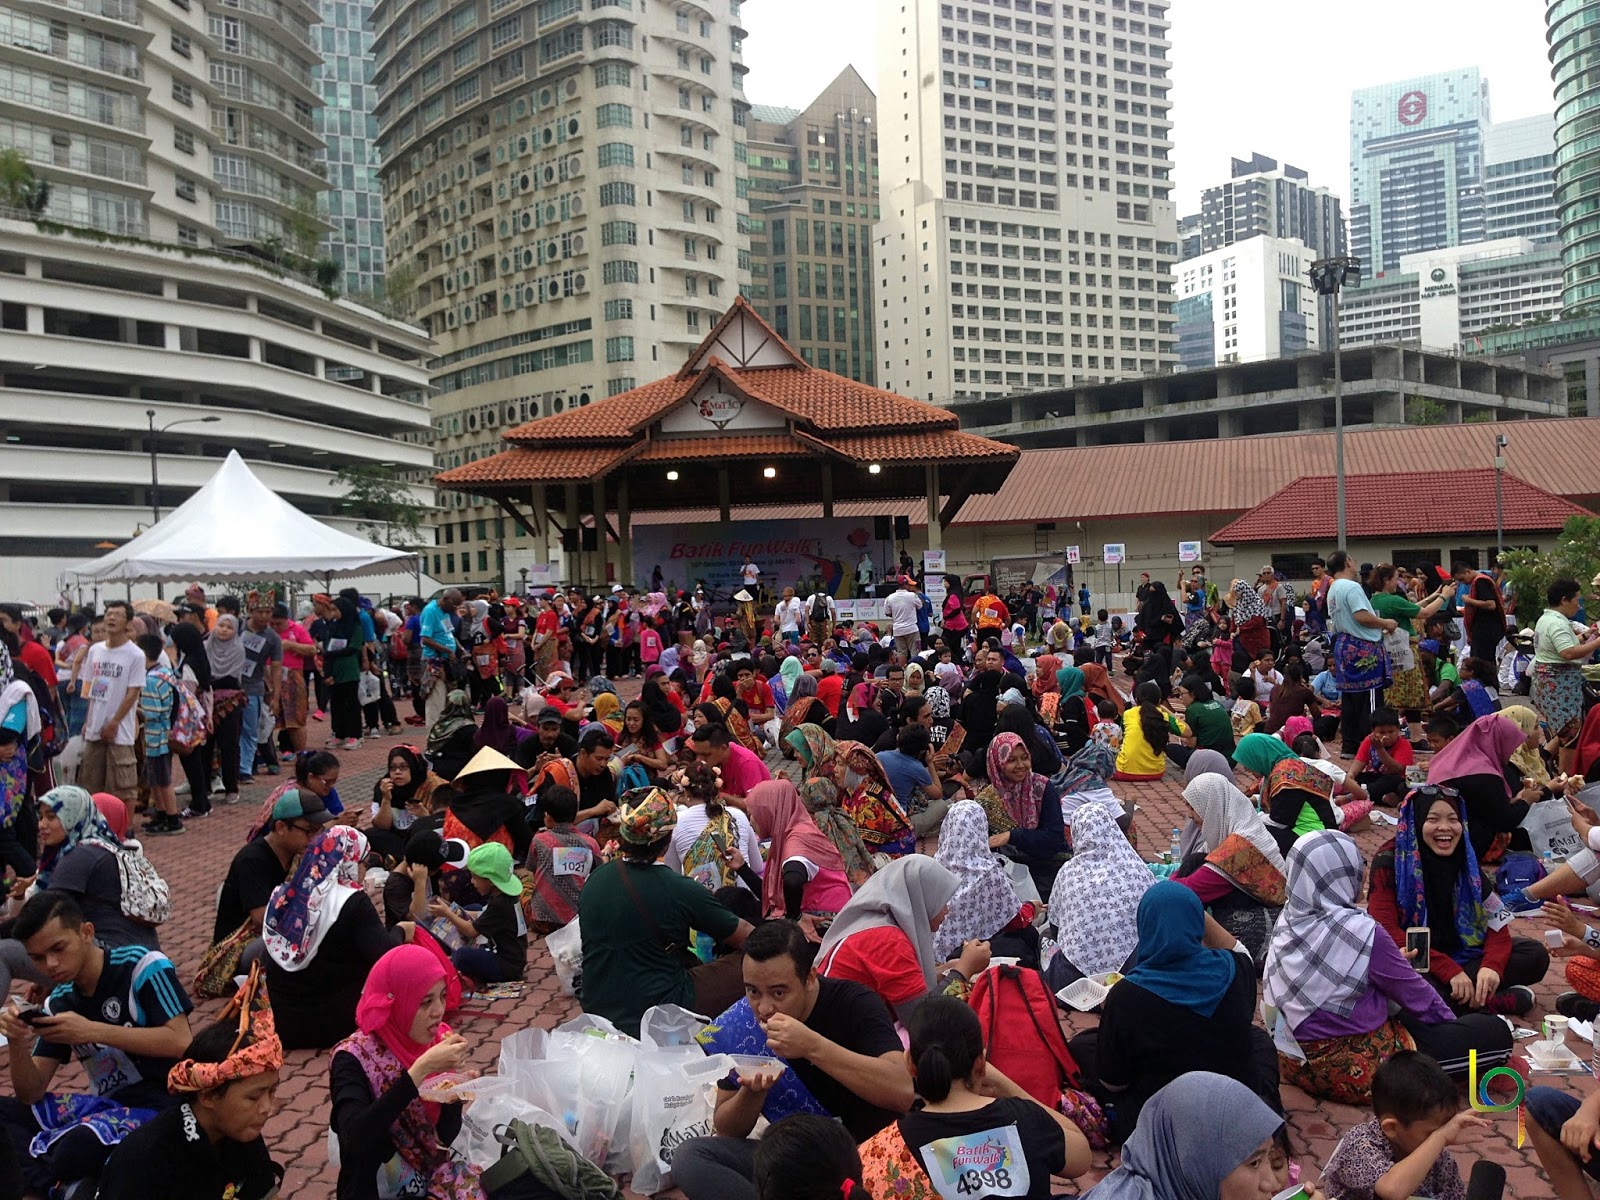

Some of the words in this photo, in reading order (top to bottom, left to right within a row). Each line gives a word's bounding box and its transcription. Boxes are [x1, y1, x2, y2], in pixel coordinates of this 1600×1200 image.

[1424, 283, 1454, 292] MENARA
[1438, 289, 1456, 297] SENG
[670, 542, 723, 559] Batik
[767, 538, 811, 555] Walk
[562, 862, 585, 873] 1021
[956, 1143, 991, 1155] Batik
[952, 1157, 972, 1169] Fun
[973, 1153, 1001, 1165] Walk
[956, 1168, 1012, 1195] 4398
